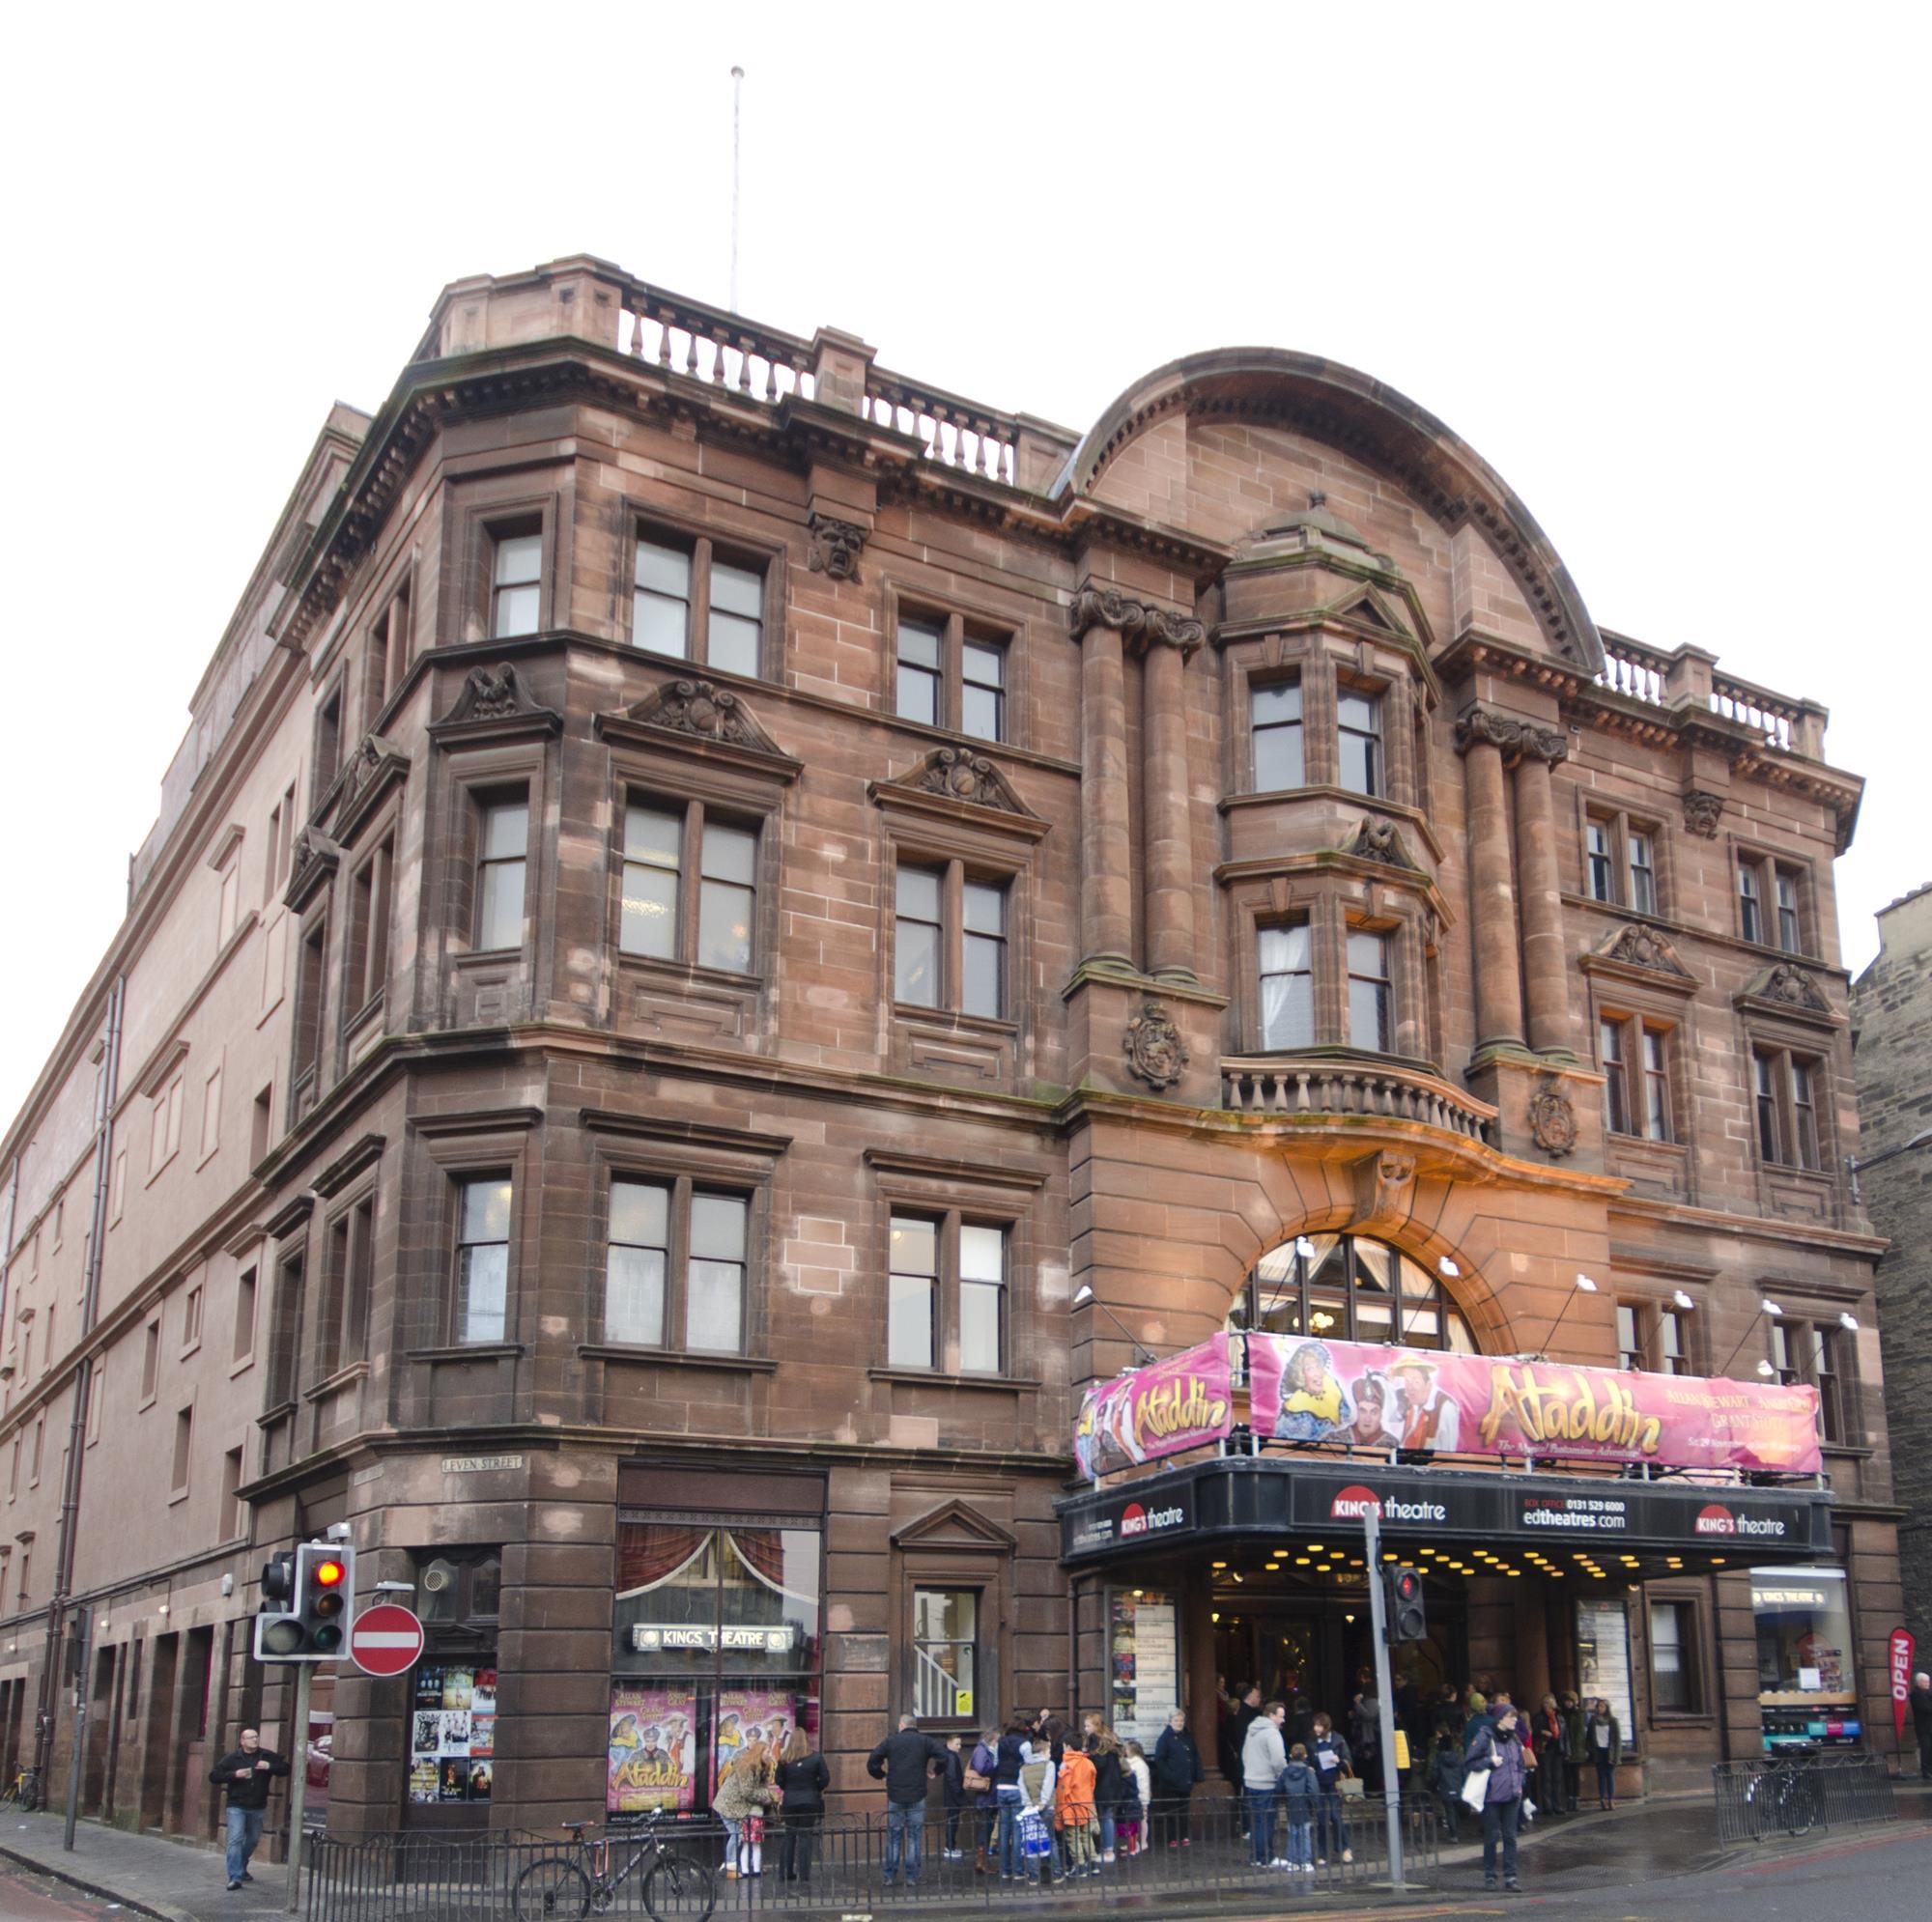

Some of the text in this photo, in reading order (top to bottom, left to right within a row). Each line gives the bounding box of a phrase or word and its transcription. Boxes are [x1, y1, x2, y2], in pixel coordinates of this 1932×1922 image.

[1135, 1374, 1226, 1449] Aladdin
[1481, 1366, 1661, 1454] Aladdin
[1498, 1440, 1515, 1450] The
[444, 1457, 518, 1471] LEVEN STREET
[1384, 1495, 1445, 1520] theatre
[1542, 1499, 1564, 1509] OFFICE
[1566, 1499, 1586, 1510] 0131
[1588, 1500, 1604, 1511] 529
[1148, 1507, 1183, 1529] theatre
[1699, 1513, 1785, 1535] KING'S theatre
[663, 1630, 702, 1645] KINGS
[1892, 1638, 1910, 1700] OPEN
[611, 1761, 689, 1792] Aladdin
